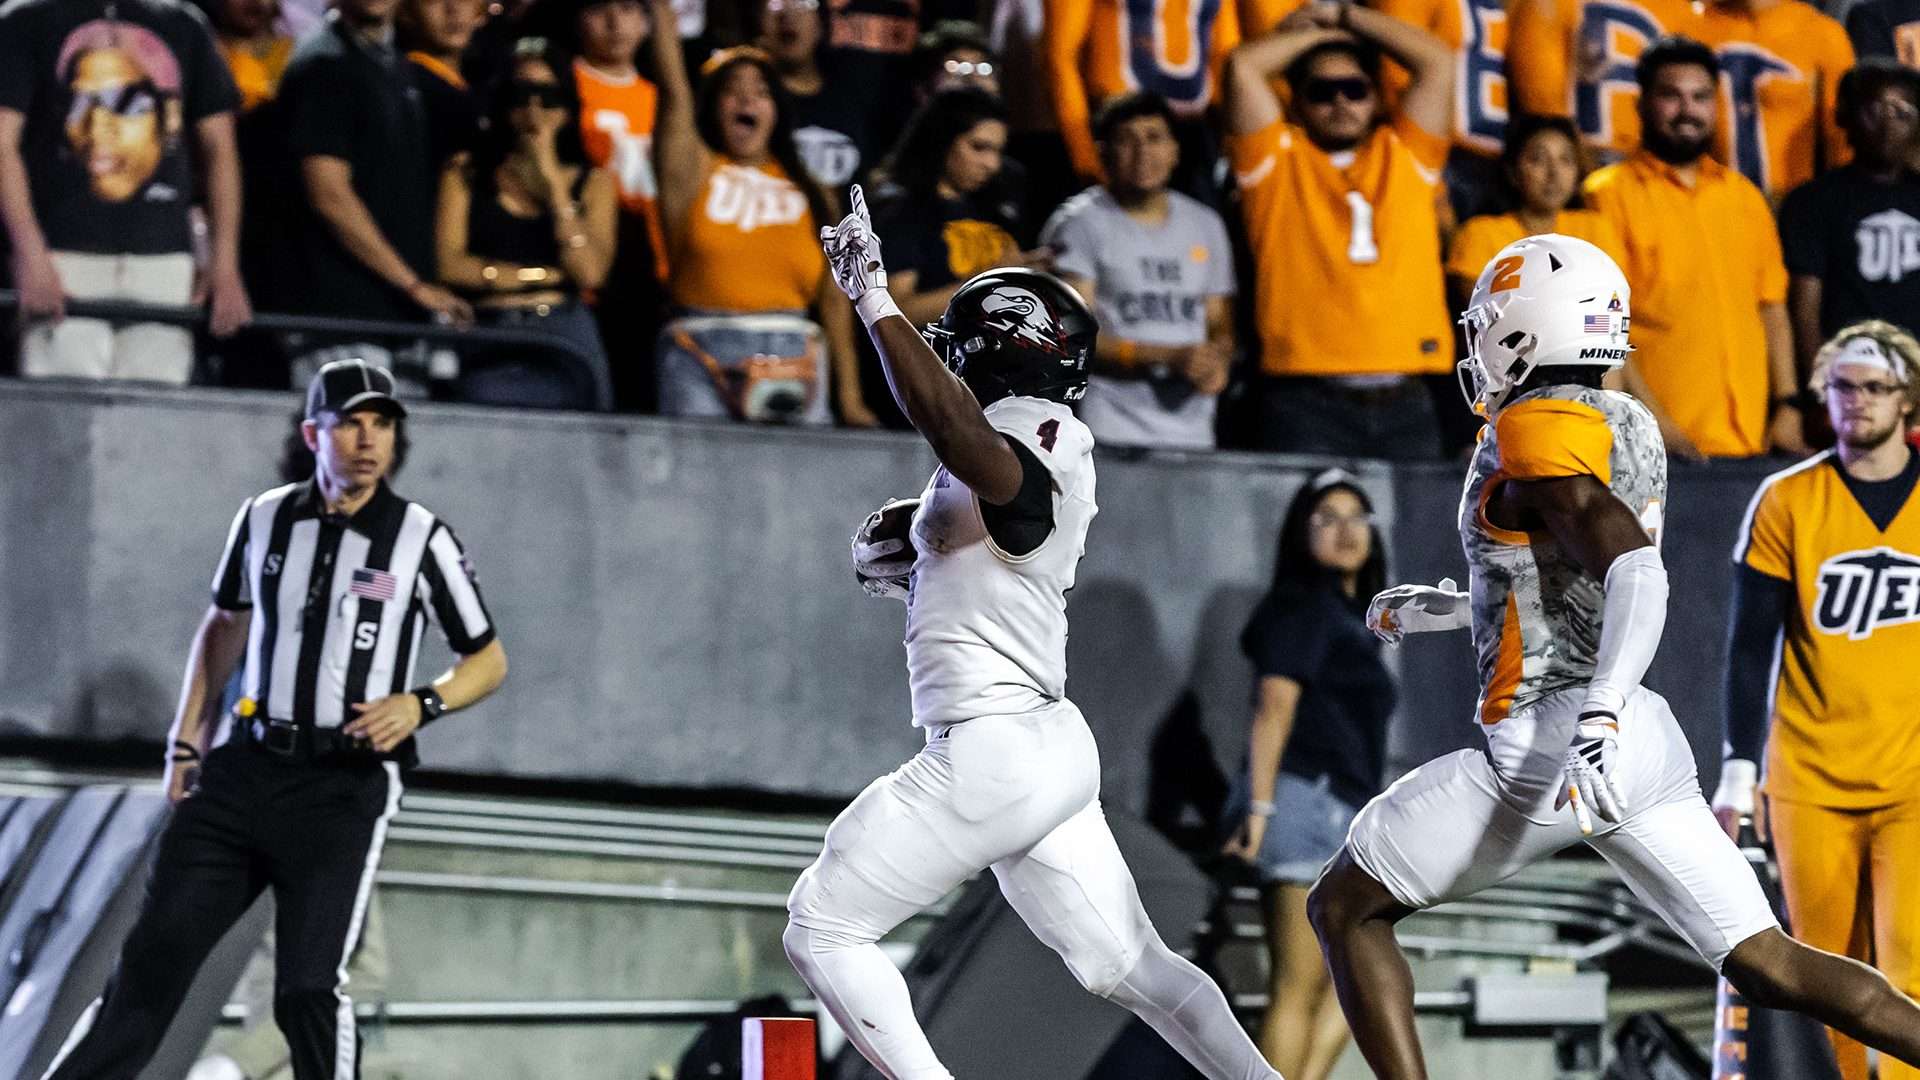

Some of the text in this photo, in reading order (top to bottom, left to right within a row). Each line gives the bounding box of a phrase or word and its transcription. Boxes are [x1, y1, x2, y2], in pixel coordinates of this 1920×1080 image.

[1347, 190, 1380, 264] 1
[1489, 255, 1525, 294] 2
[1036, 418, 1061, 454] 4
[263, 553, 283, 576] S
[1813, 546, 1920, 640] UTE
[354, 621, 379, 651] S
